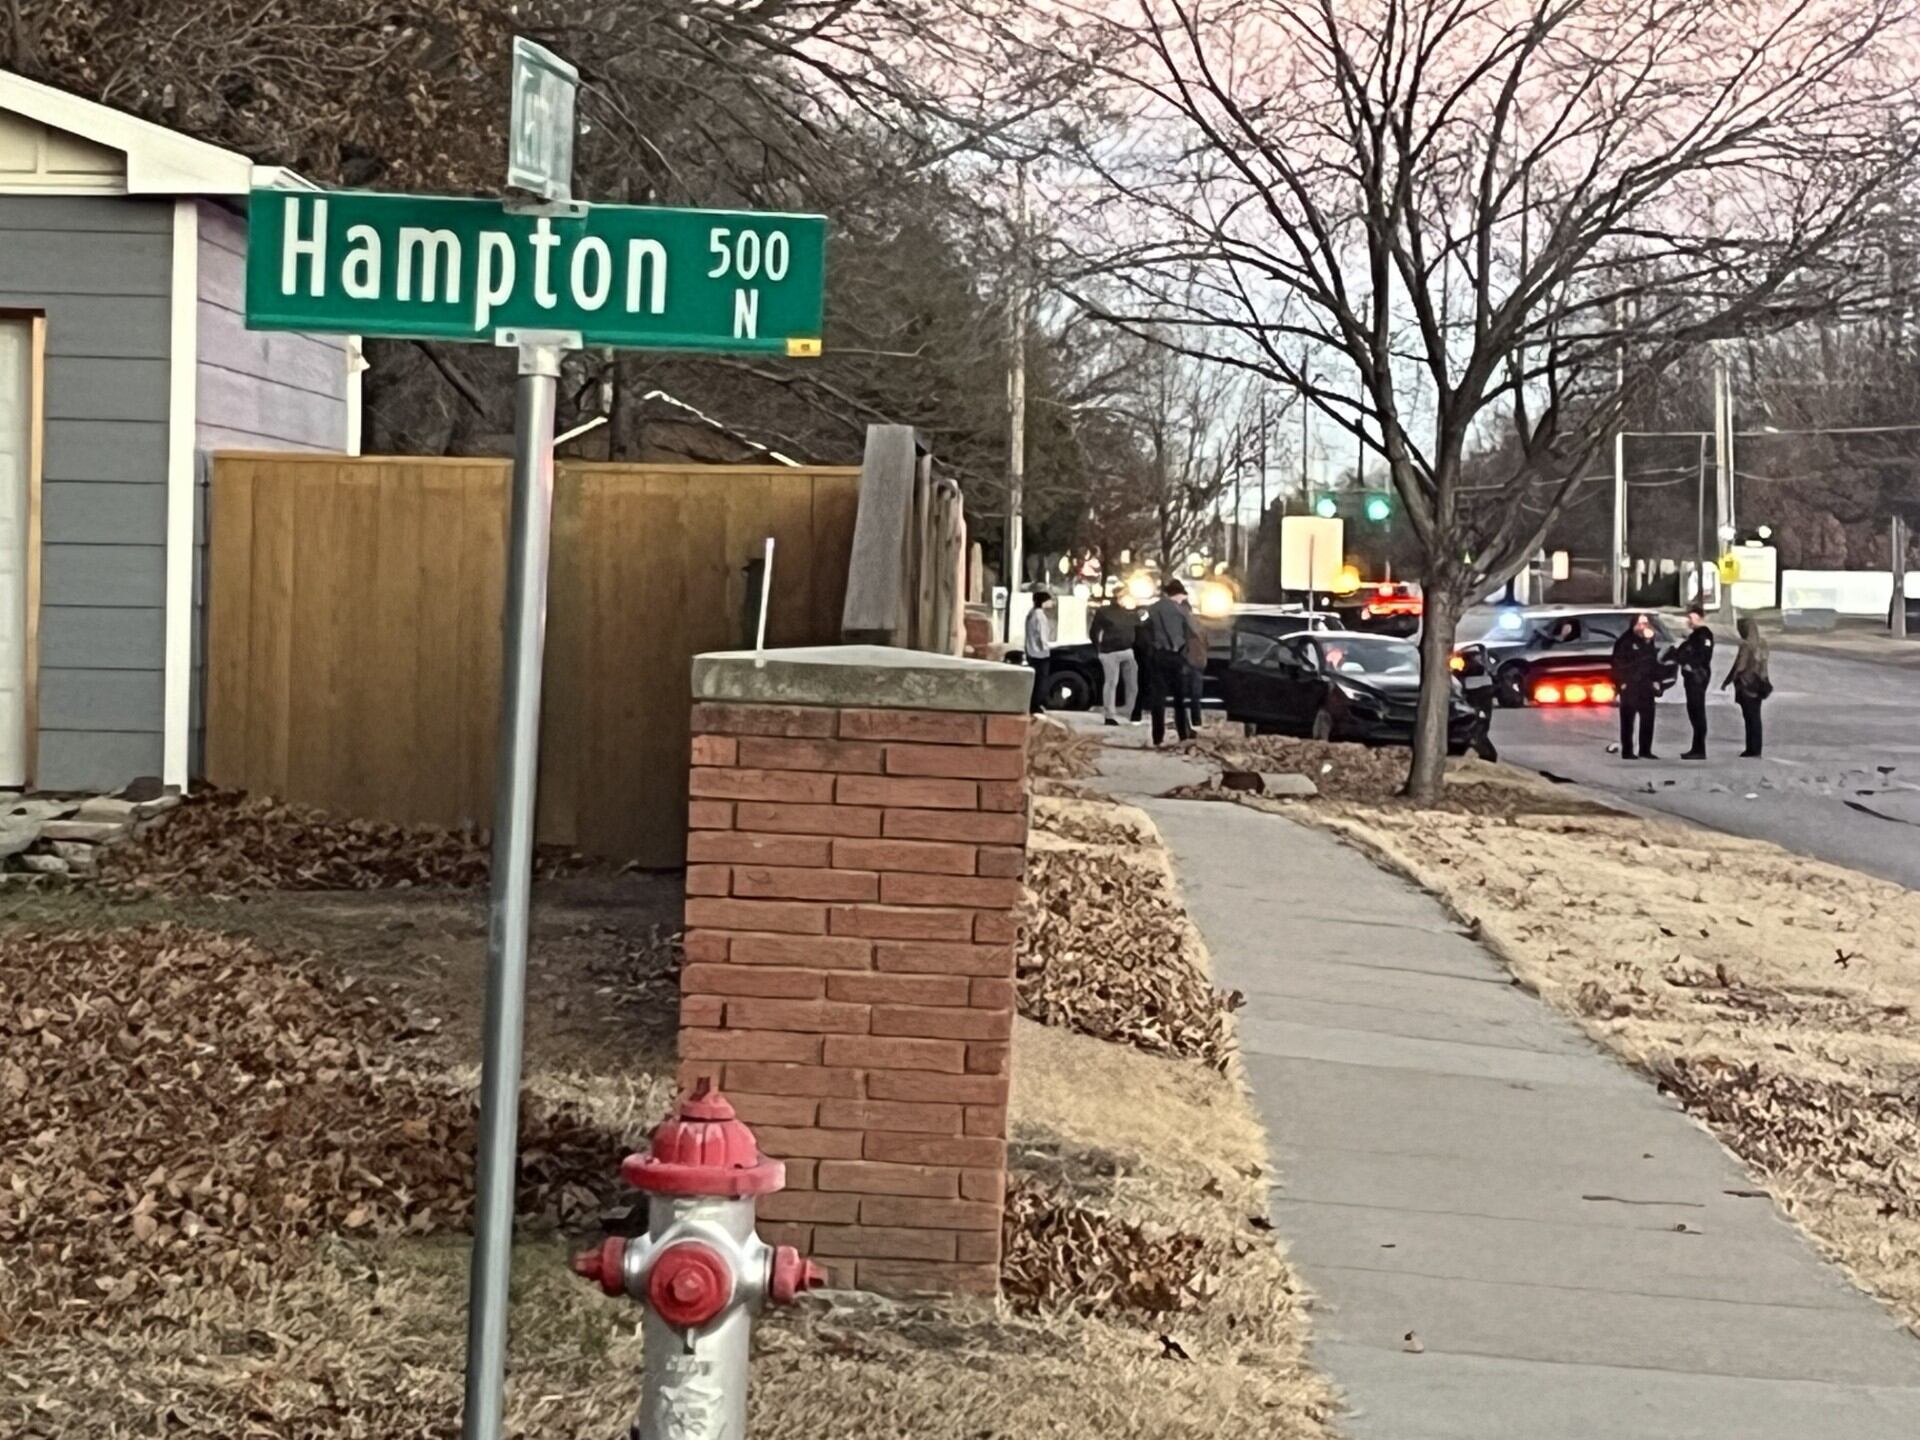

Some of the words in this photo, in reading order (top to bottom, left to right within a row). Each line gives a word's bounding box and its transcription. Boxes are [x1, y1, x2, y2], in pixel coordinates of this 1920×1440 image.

[281, 196, 667, 331] Hampton
[708, 228, 790, 282] 500
[734, 288, 759, 339] N
